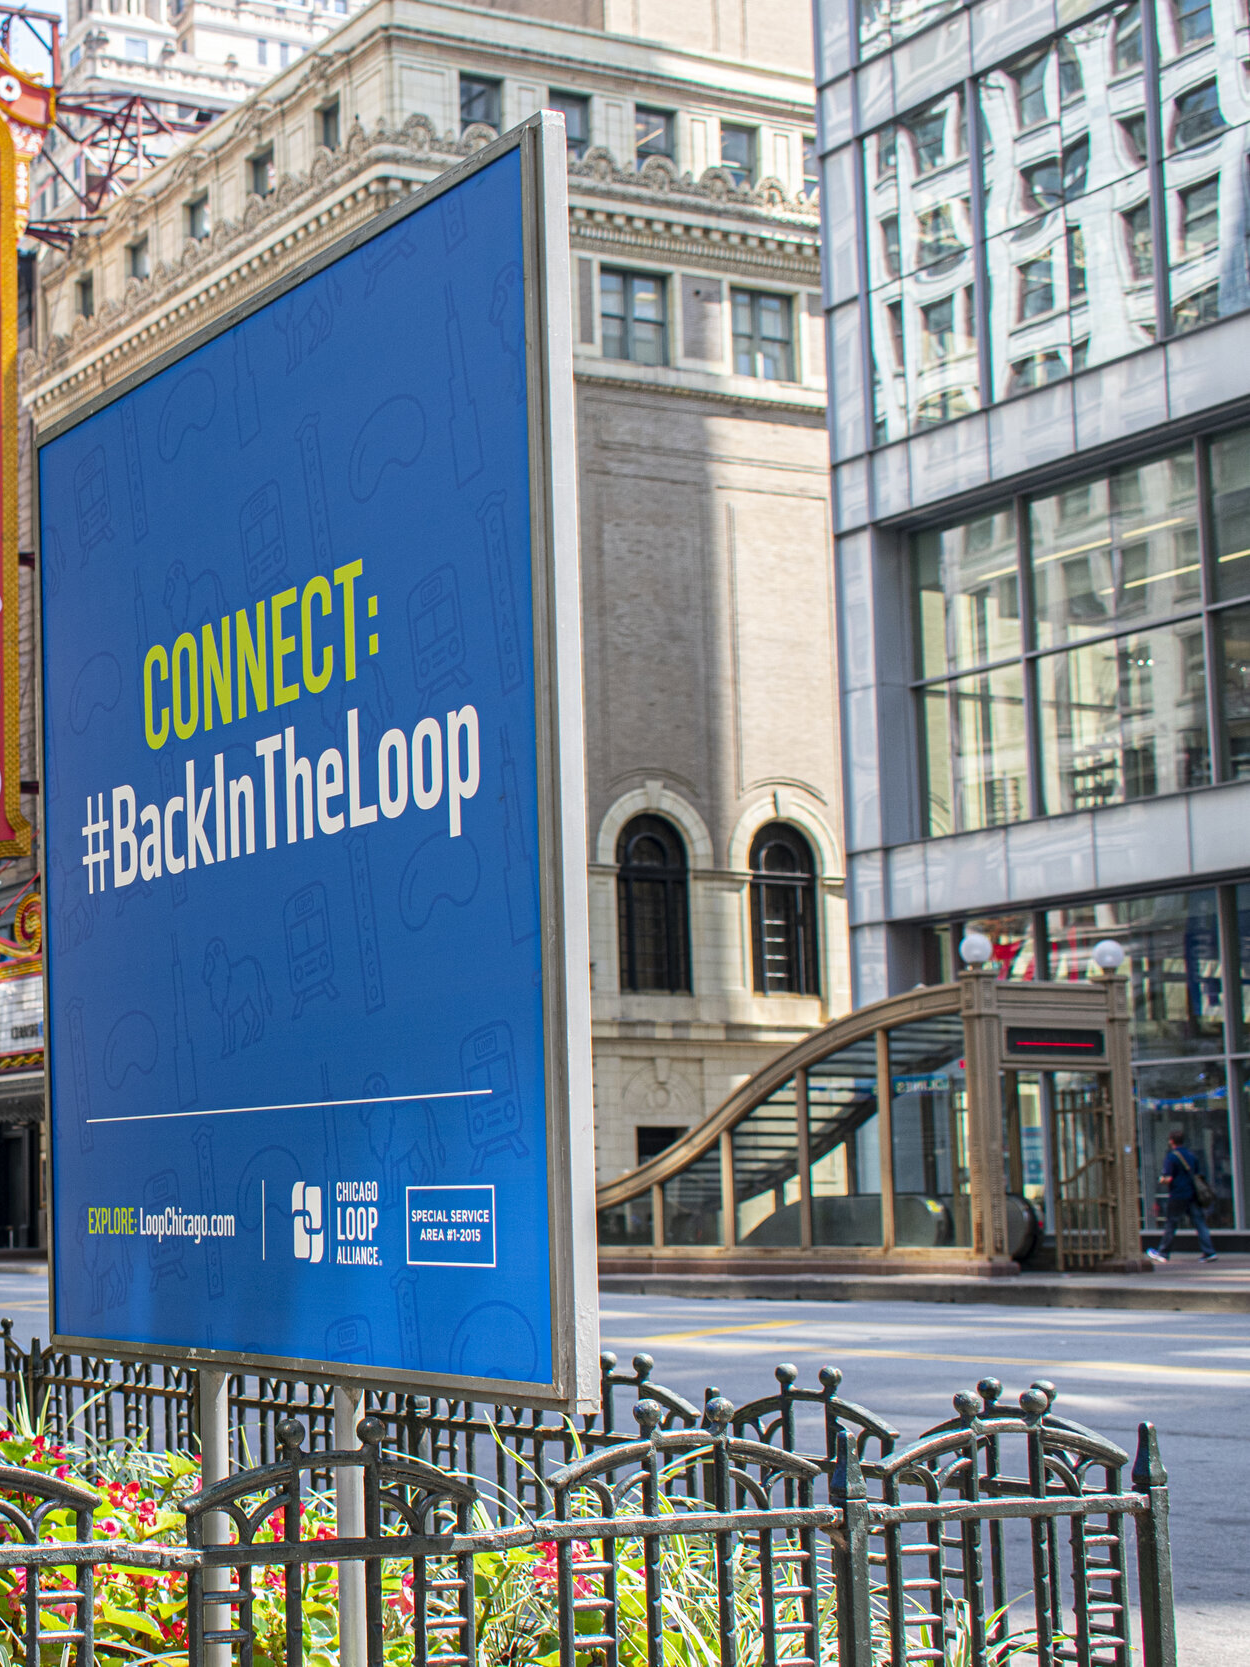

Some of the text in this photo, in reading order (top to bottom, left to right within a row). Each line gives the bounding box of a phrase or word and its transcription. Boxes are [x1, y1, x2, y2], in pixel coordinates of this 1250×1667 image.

[143, 558, 379, 750] CONNECT:
[81, 704, 479, 894] #BackInTheLoop
[336, 1181, 378, 1202] CHICAGO
[88, 1206, 236, 1244] EXPLORE: LoopChicago.com
[336, 1207, 379, 1241] LOOP
[411, 1210, 490, 1223] SPECIAL SERVICE
[420, 1229, 481, 1242] AREA #1-2015
